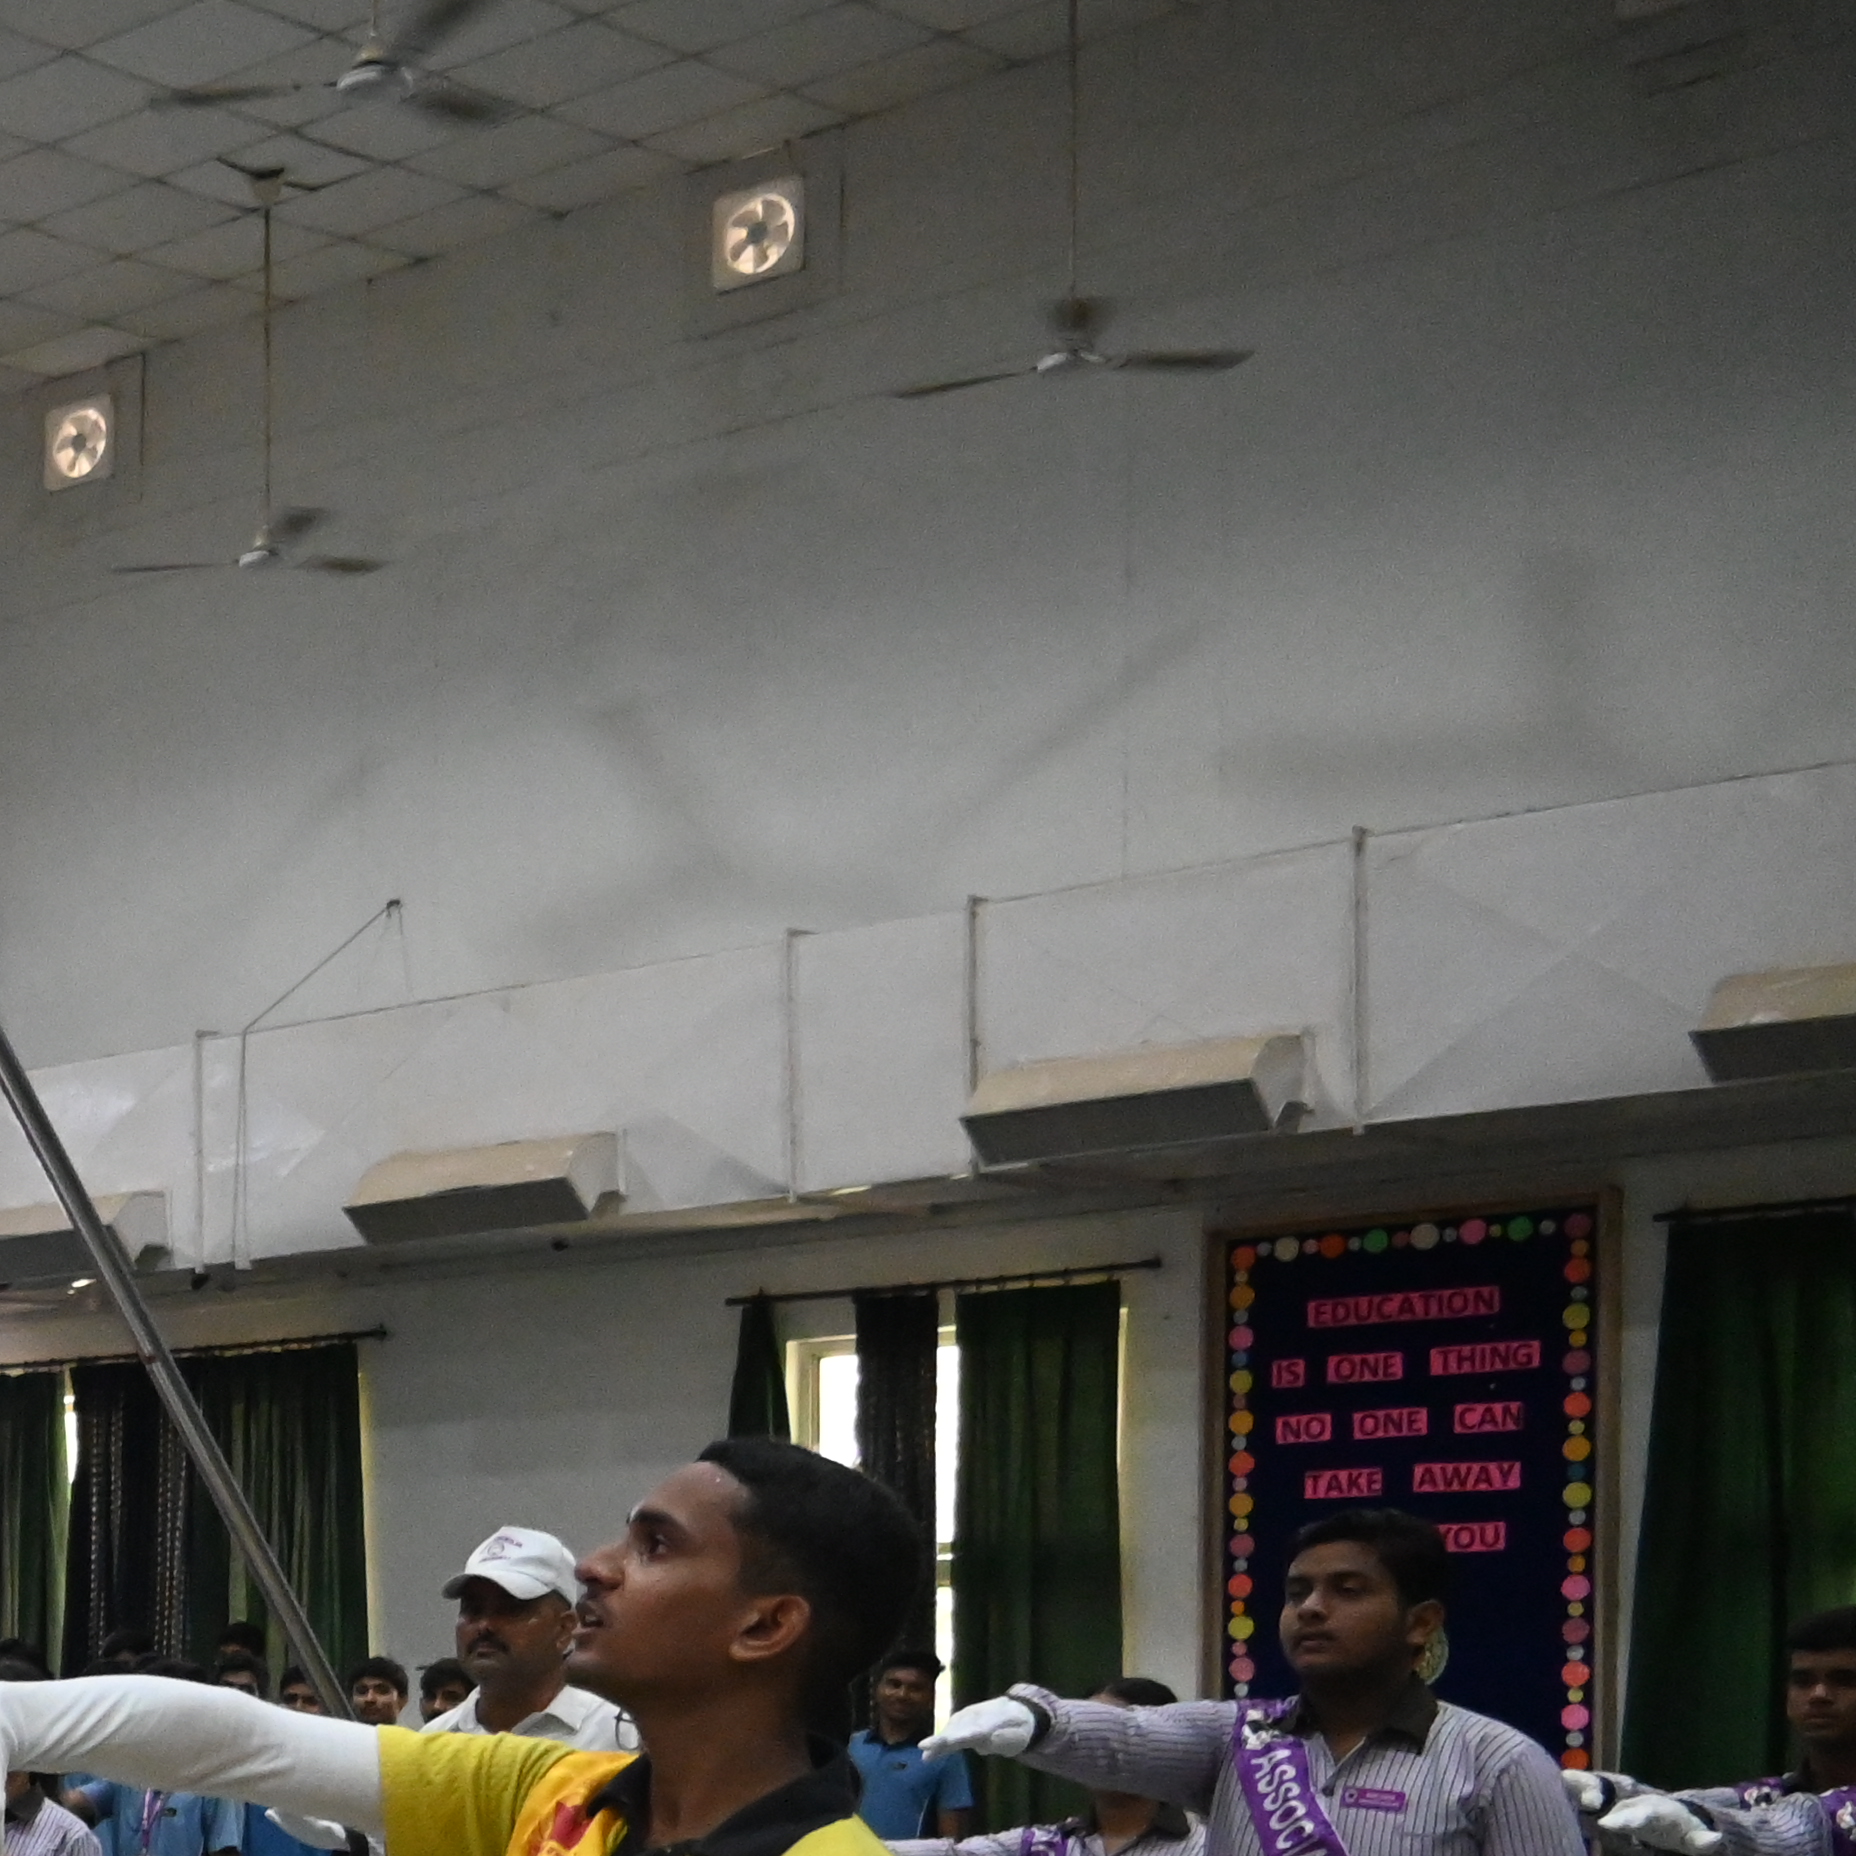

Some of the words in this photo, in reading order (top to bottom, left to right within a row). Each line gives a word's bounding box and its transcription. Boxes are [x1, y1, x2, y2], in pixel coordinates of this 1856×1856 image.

[1314, 1290, 1499, 1324] EDUCATION
[1274, 1363, 1302, 1387] IS
[1332, 1354, 1399, 1381] ONE
[1437, 1344, 1534, 1372] THING
[1282, 1416, 1326, 1442] NO
[1357, 1410, 1423, 1437] ONE
[1459, 1404, 1522, 1431] CAN
[1306, 1473, 1382, 1496] TAKE
[1418, 1464, 1517, 1489] AWAY
